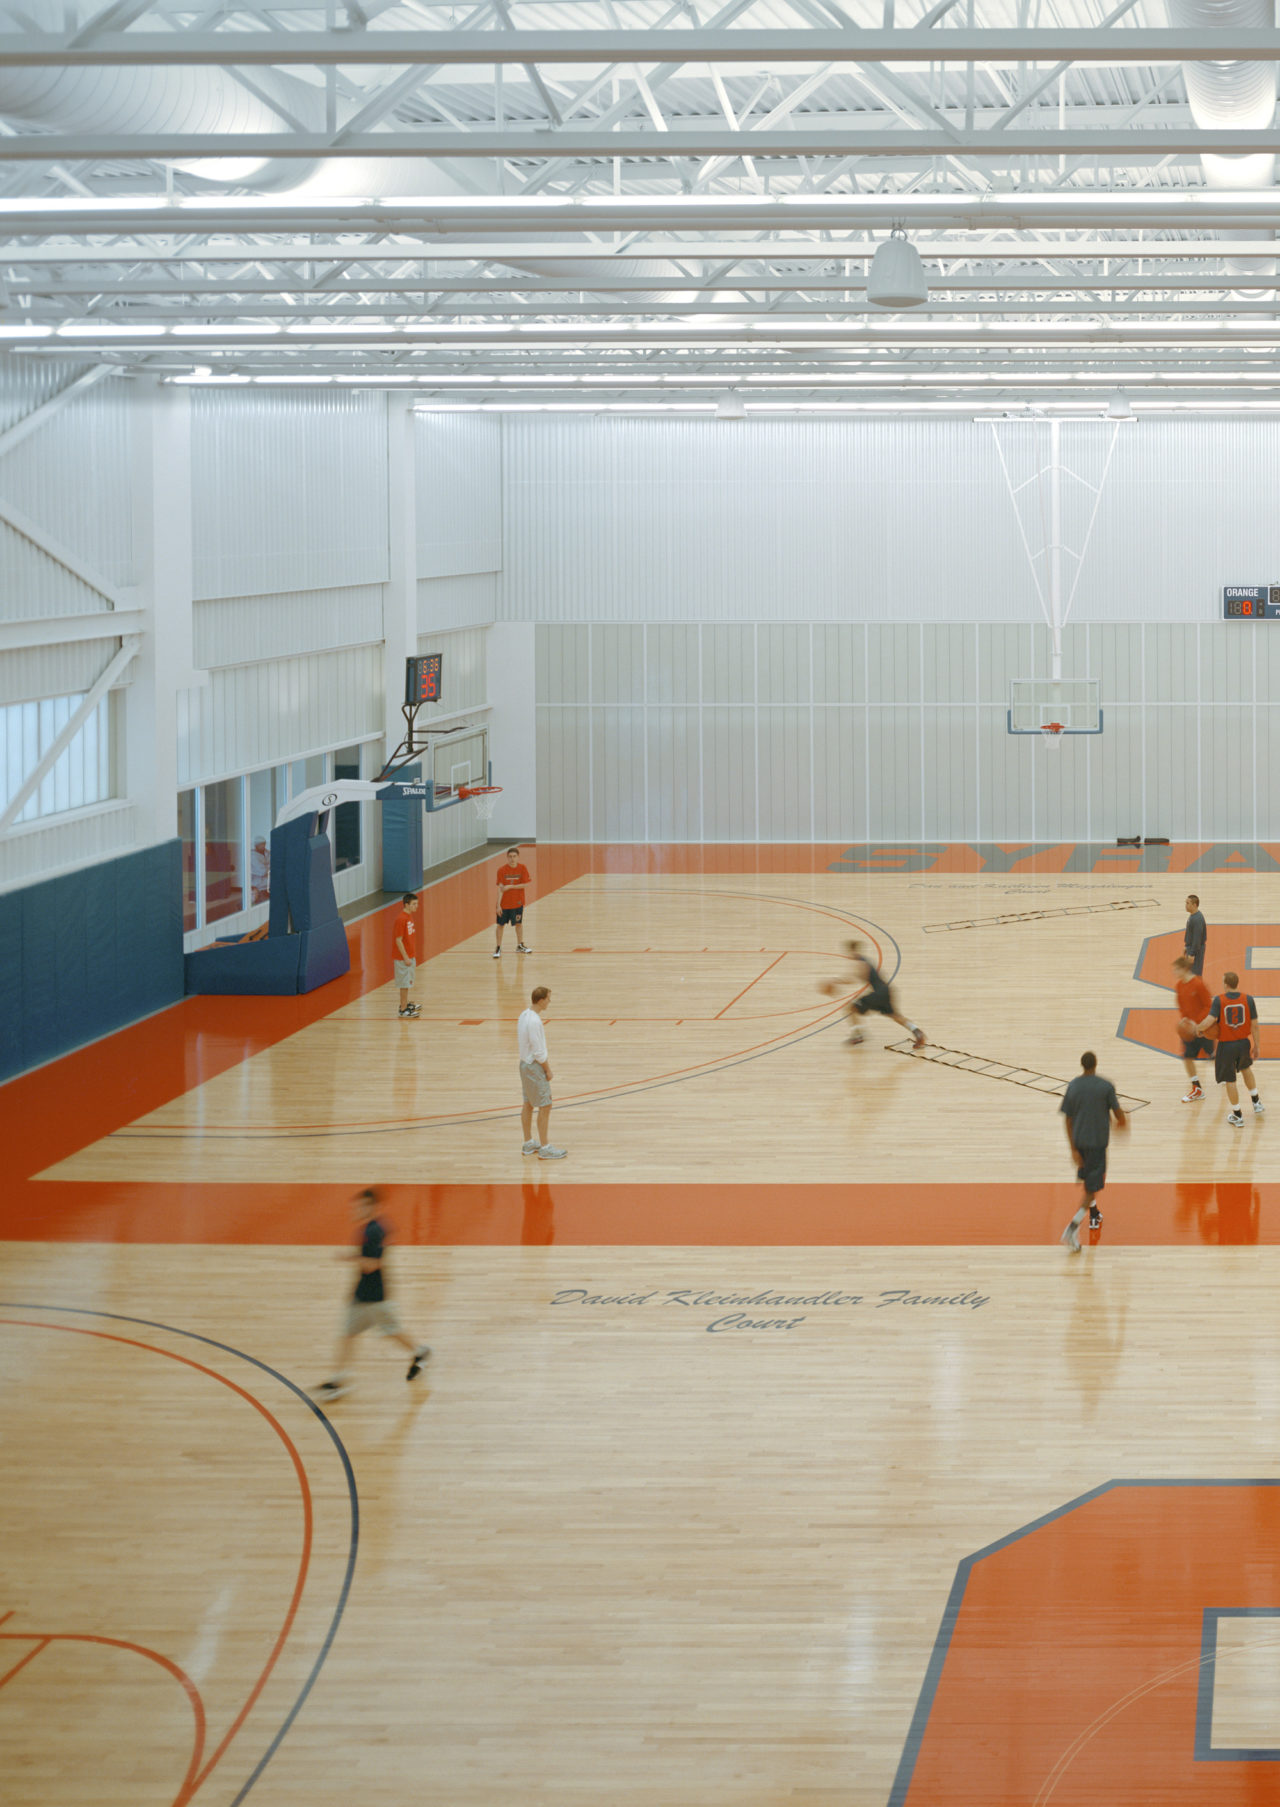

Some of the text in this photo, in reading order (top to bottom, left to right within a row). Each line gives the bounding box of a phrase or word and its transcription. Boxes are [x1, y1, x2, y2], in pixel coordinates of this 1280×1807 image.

[1226, 588, 1259, 597] ORANGE
[421, 673, 436, 699] 35
[550, 1289, 990, 1309] David Kleinhandler Family
[706, 1312, 806, 1333] Court
